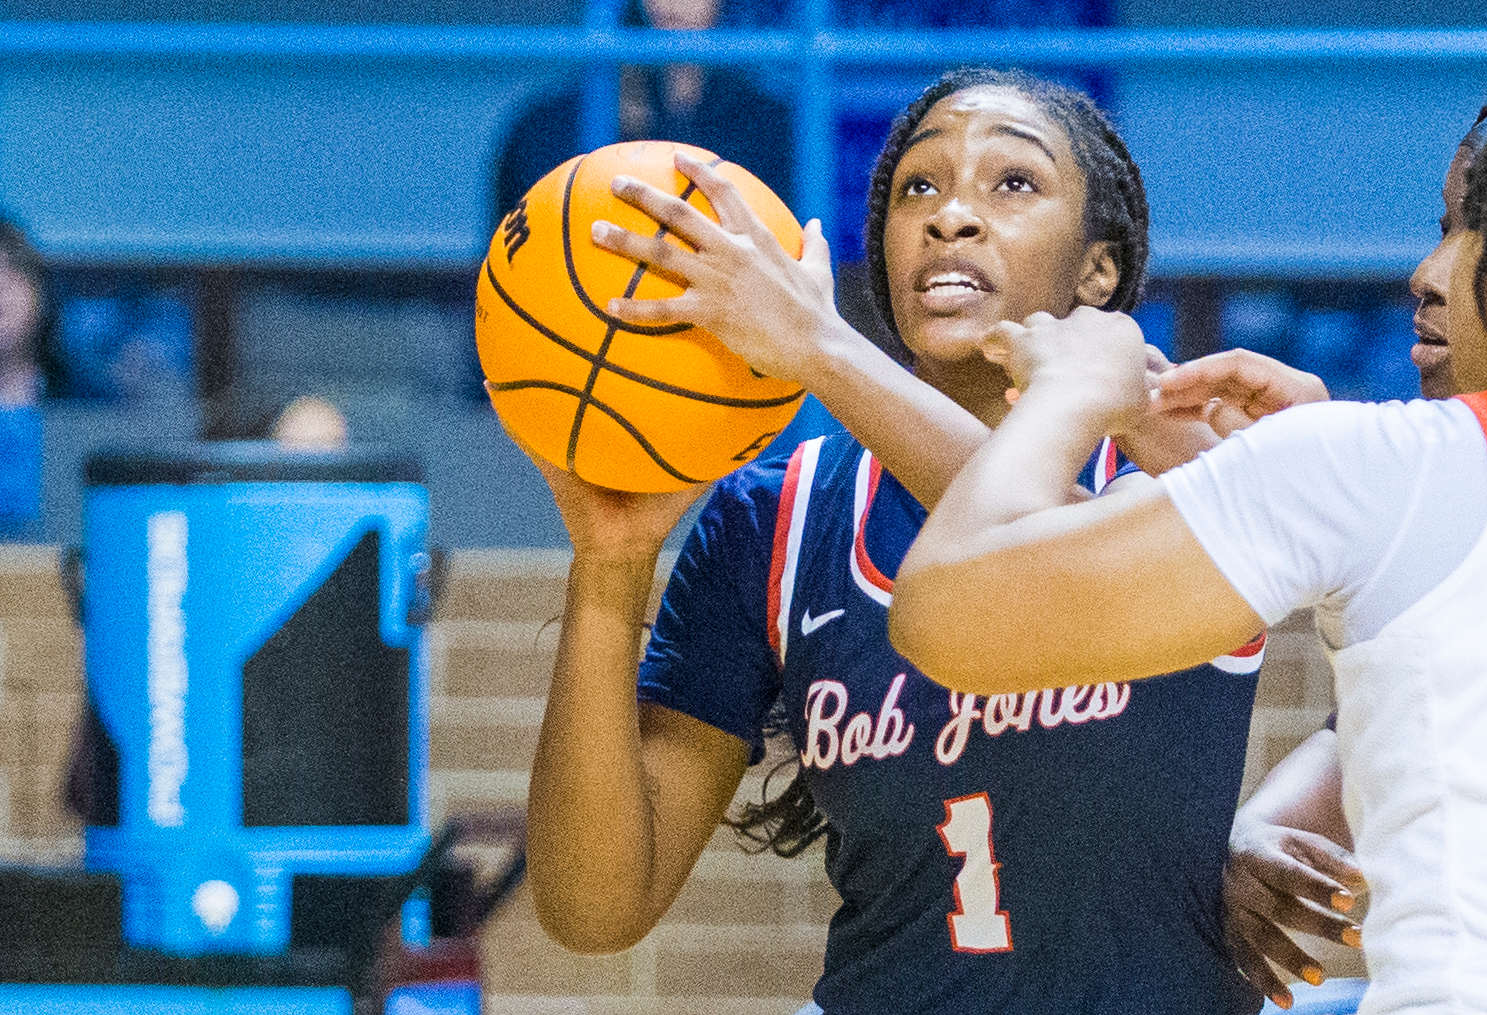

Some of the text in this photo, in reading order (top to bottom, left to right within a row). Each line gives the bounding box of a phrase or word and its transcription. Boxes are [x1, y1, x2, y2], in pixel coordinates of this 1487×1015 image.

[801, 673, 1131, 770] Bob Jones
[936, 791, 1013, 953] 1
